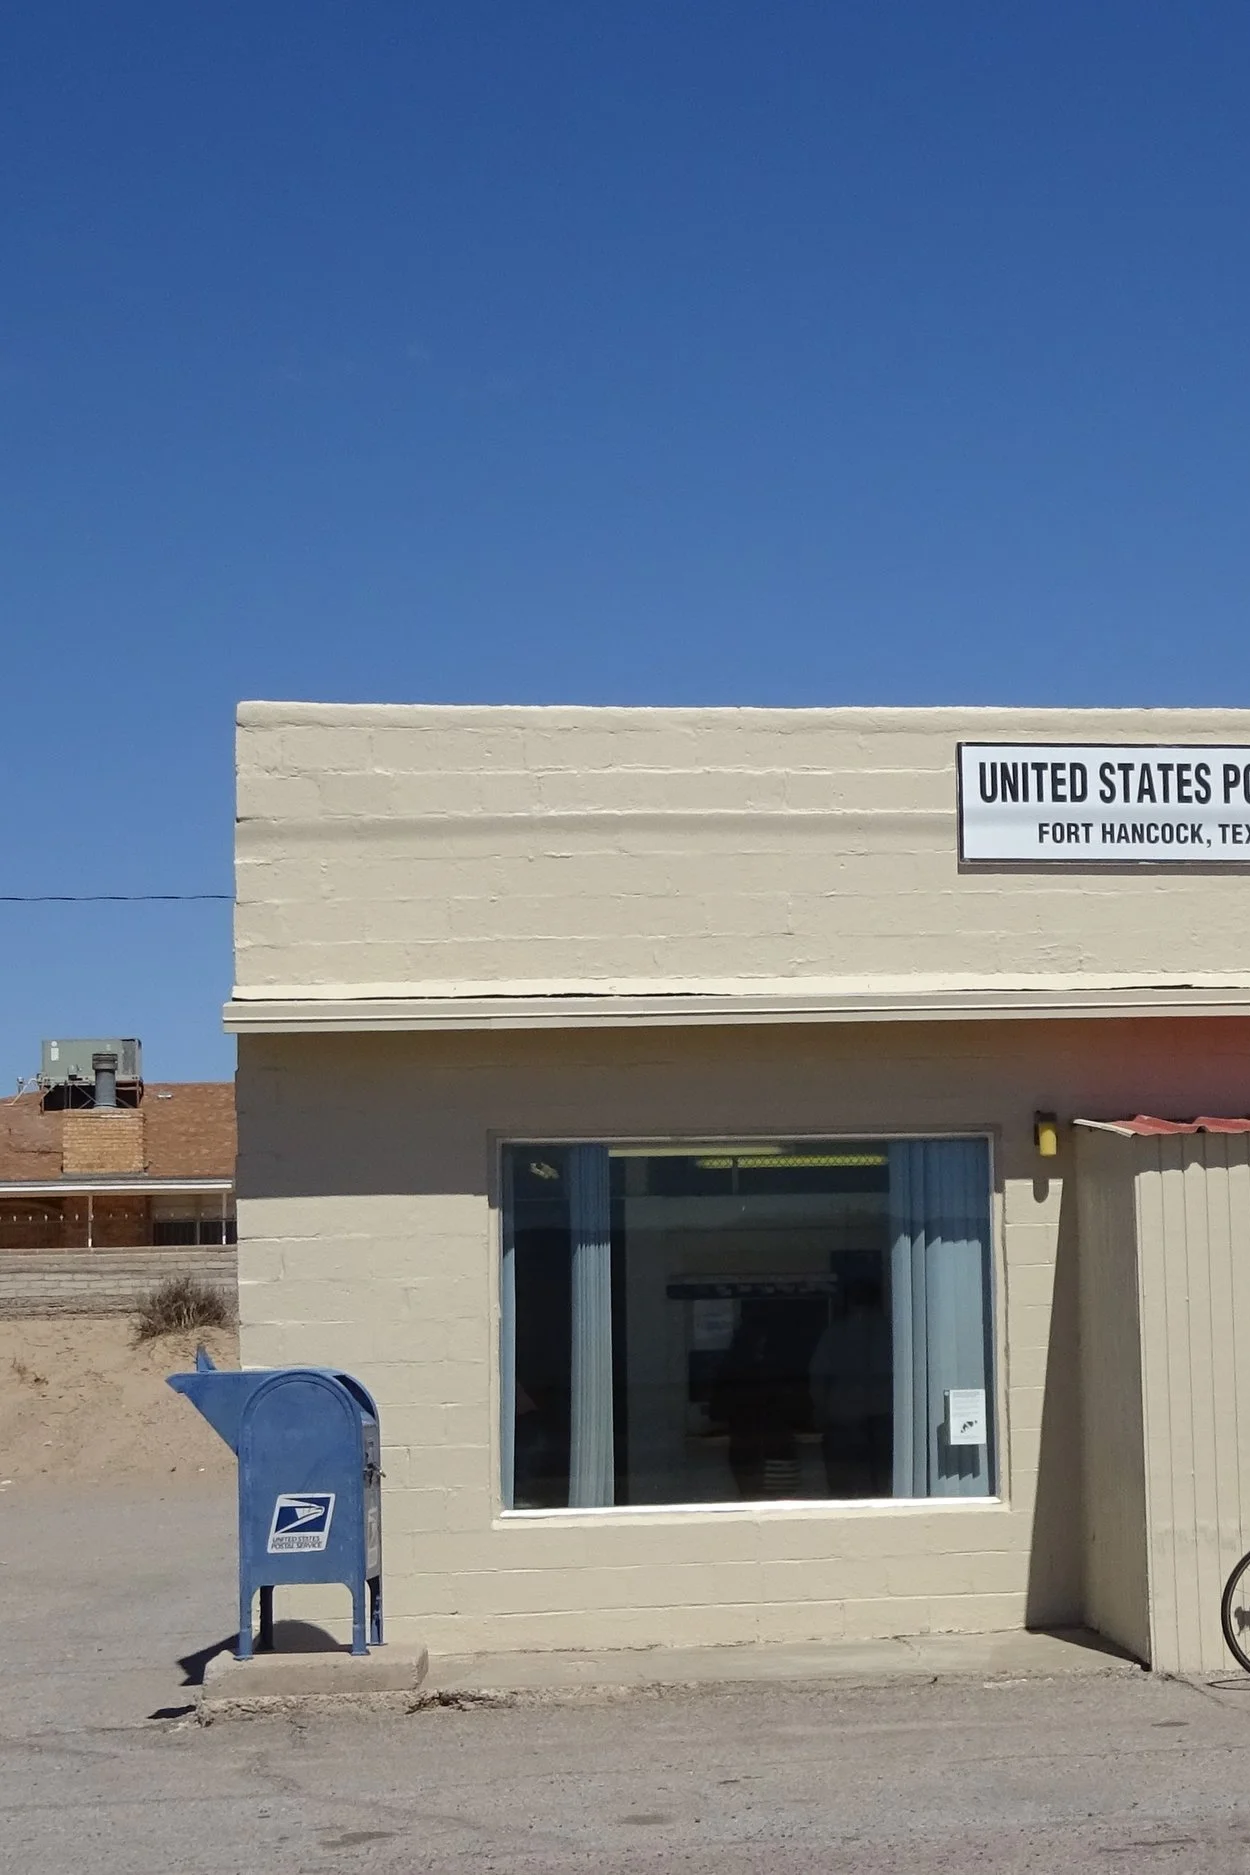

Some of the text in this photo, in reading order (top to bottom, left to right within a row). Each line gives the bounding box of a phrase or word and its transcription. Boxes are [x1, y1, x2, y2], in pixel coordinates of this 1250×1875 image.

[979, 762, 1088, 804] UNITED
[1099, 762, 1212, 805] STATES
[1038, 822, 1093, 844] FORT
[1101, 822, 1212, 848] HANCOCK,
